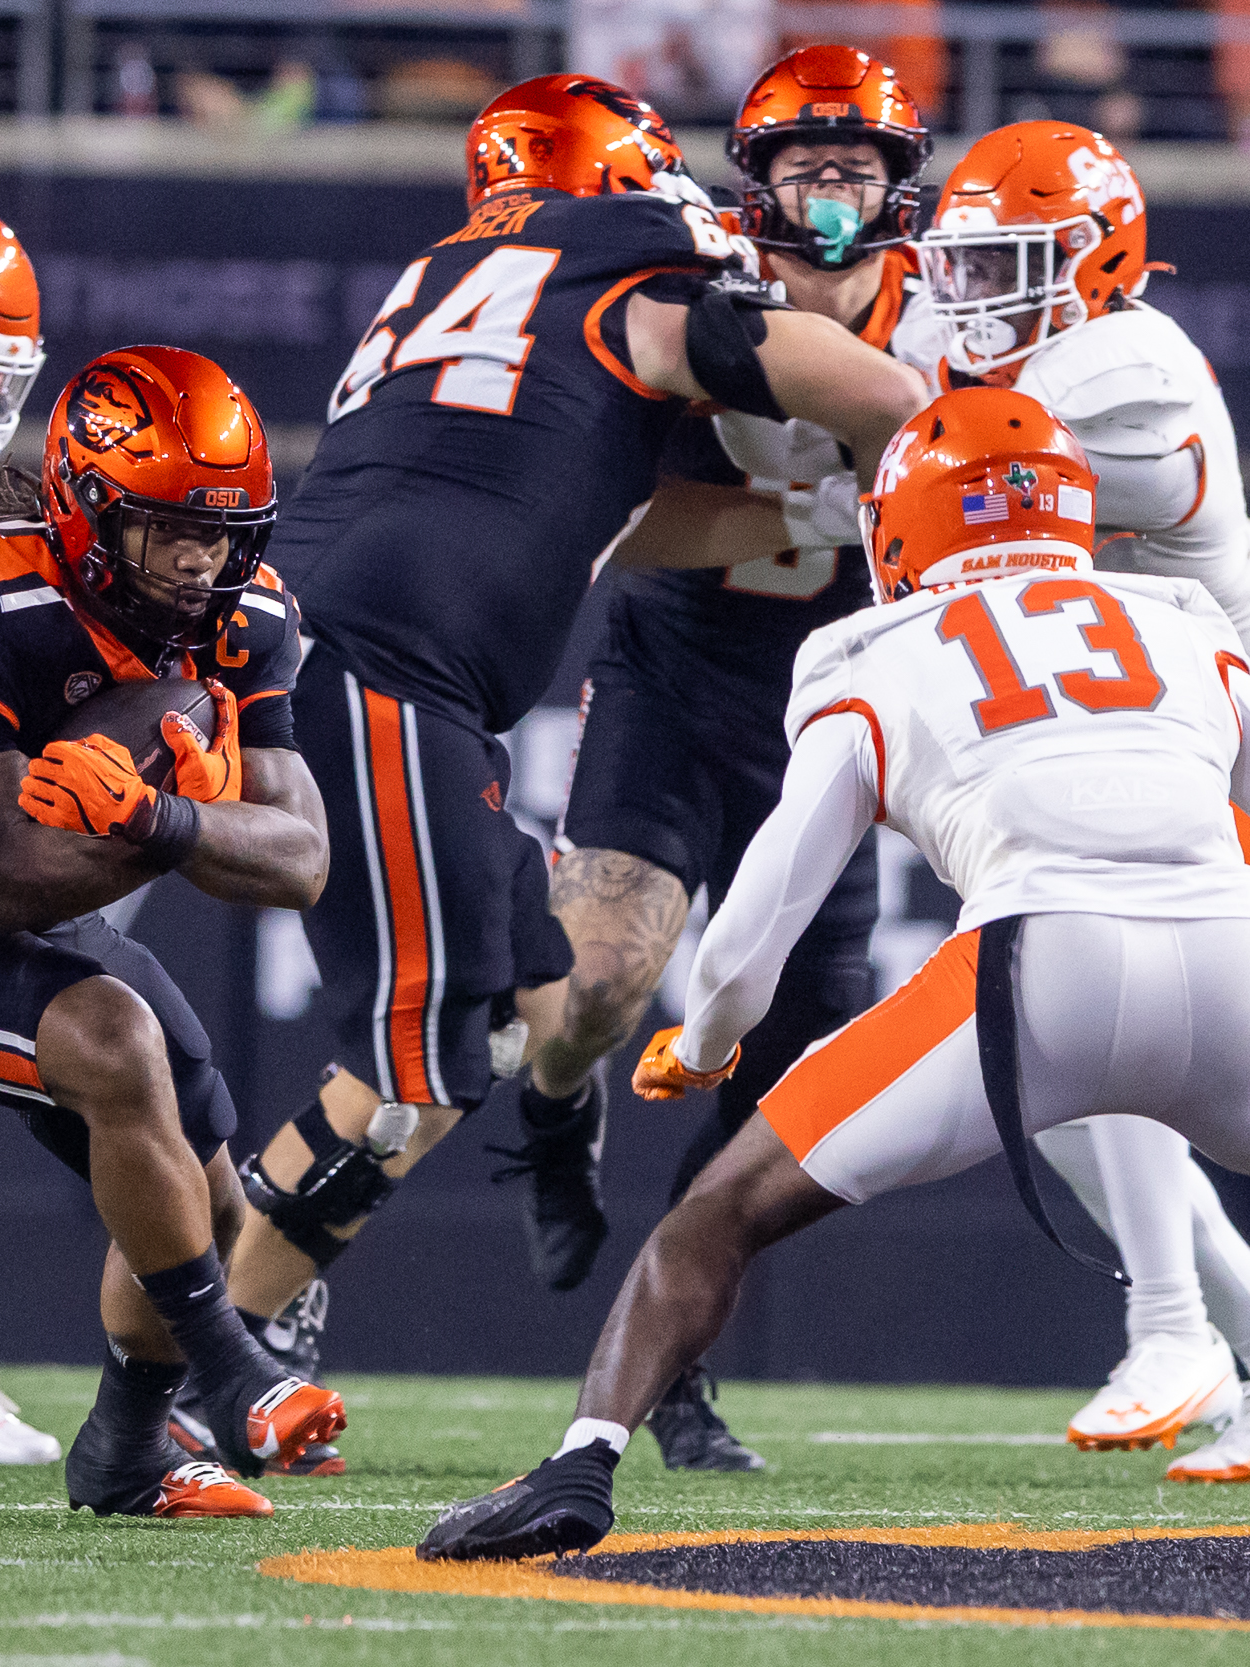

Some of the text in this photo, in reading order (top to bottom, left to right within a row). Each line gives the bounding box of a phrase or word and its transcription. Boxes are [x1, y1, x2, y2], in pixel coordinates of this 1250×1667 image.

[327, 244, 562, 425] 64
[205, 490, 241, 507] OSU
[1039, 493, 1054, 511] 13
[960, 553, 1078, 573] SAM HOUSTON
[216, 610, 249, 668] C
[935, 578, 1168, 738] 13
